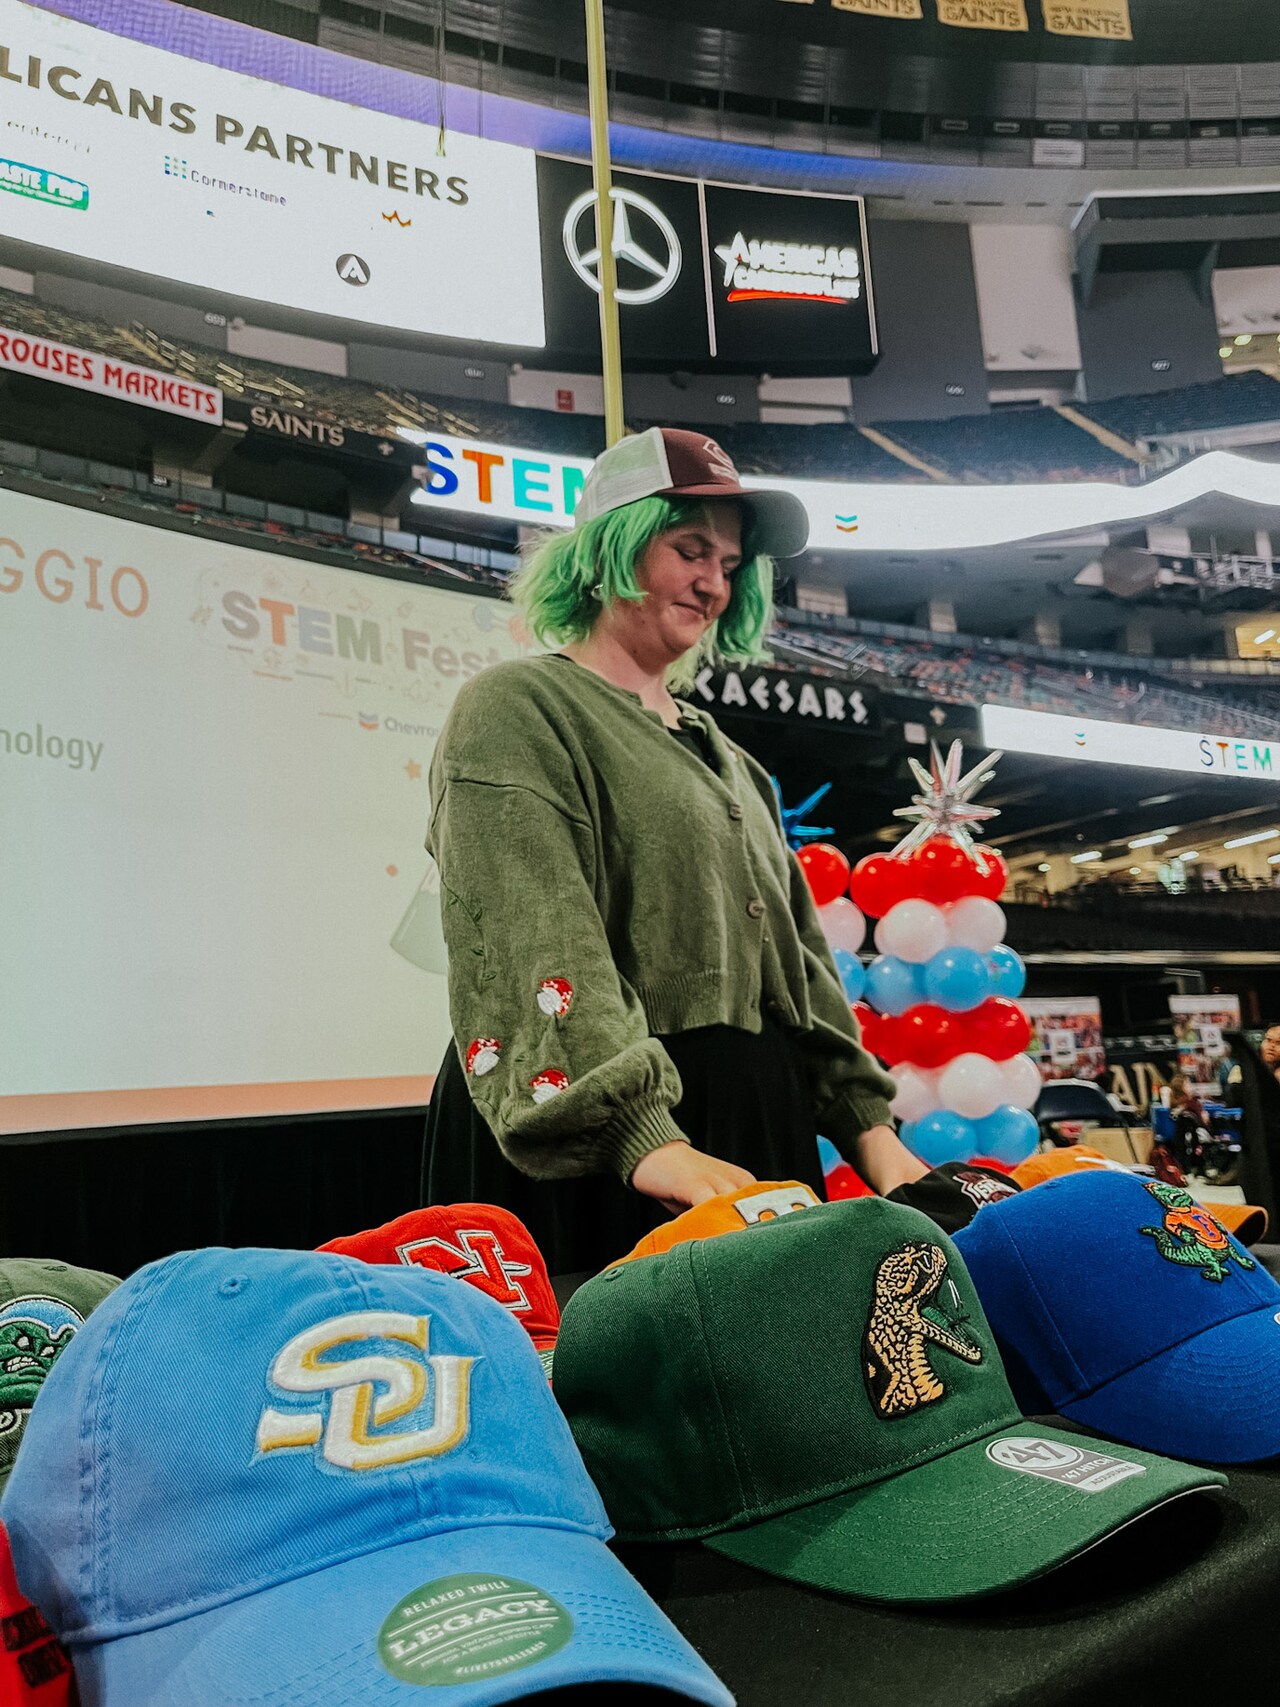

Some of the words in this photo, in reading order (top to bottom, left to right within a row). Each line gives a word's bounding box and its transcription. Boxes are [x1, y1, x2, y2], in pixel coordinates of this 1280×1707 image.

[1049, 14, 1125, 35] SAINTS
[0, 44, 197, 134] LICANS
[216, 114, 470, 206] PARTNERS
[191, 170, 287, 206] Cornerstone
[0, 335, 94, 379] ROUSES
[104, 364, 217, 415] MARKETS
[250, 406, 345, 447] SAINTS
[221, 590, 384, 665] STEM
[695, 667, 868, 724] CAESARS
[1199, 739, 1273, 772] STEM
[247, 1311, 484, 1473] SU
[403, 1588, 465, 1617] RELAXED
[468, 1580, 511, 1595] TWILL
[389, 1599, 557, 1660] LEGACY
